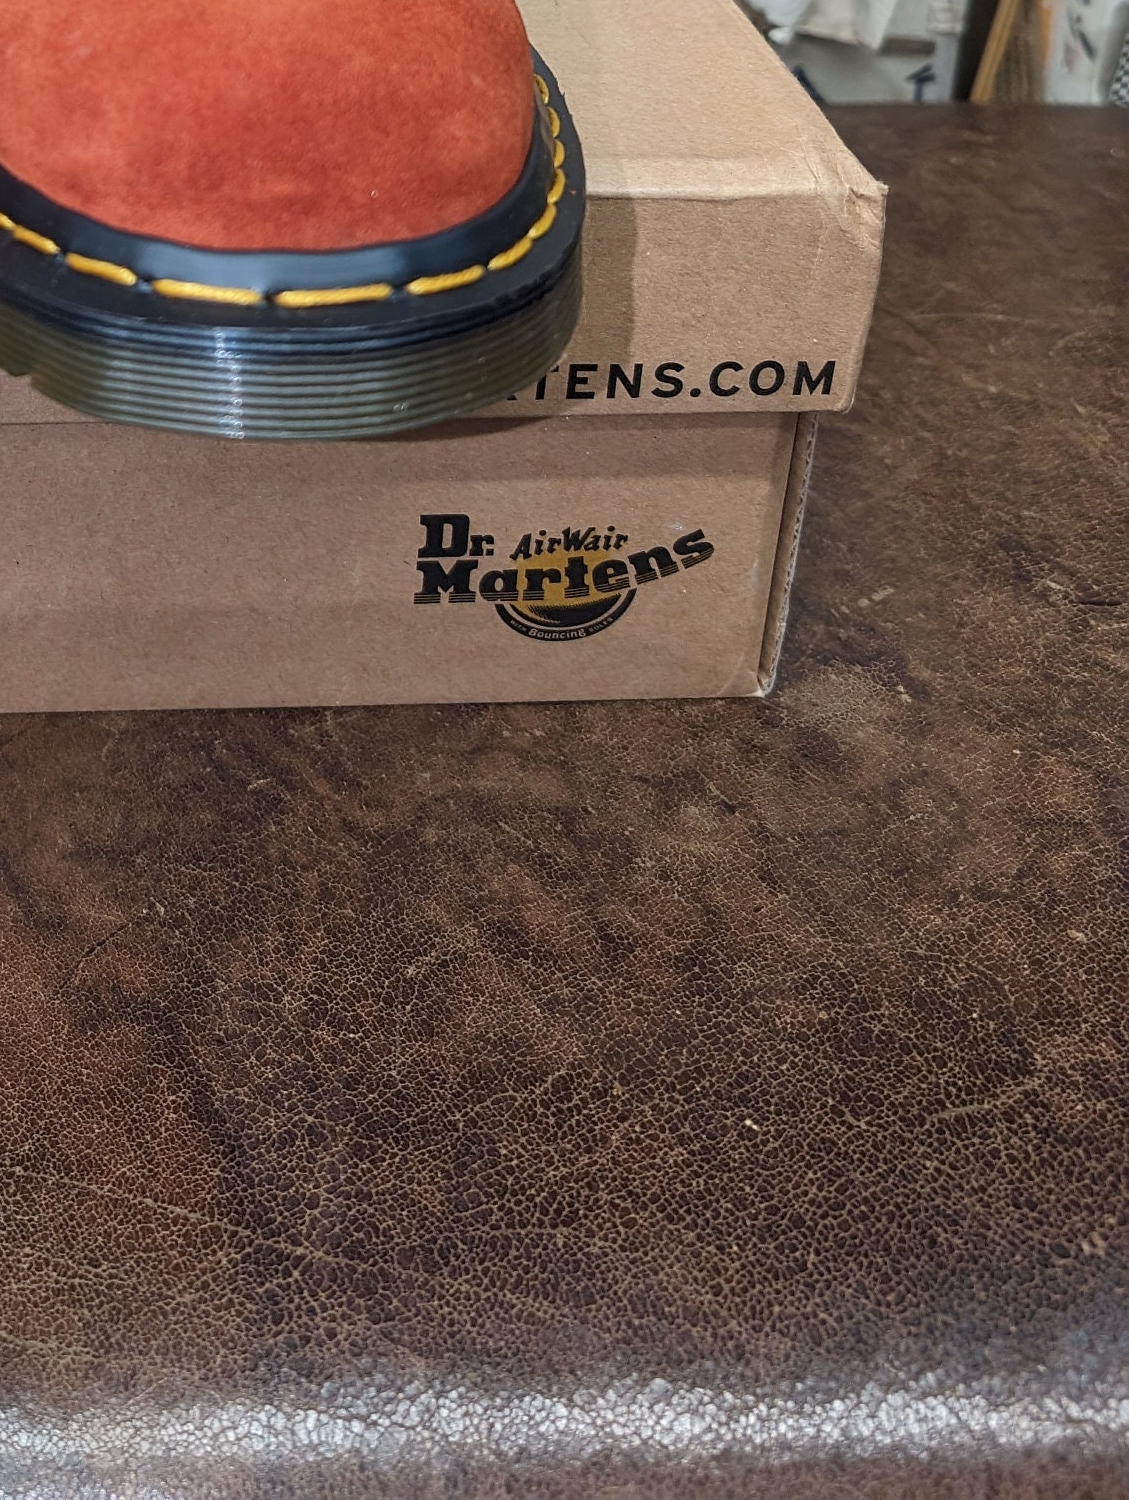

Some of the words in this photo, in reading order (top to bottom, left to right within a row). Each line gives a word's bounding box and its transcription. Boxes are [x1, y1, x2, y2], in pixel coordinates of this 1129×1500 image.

[508, 359, 836, 402] TENS.COM
[417, 513, 495, 559] Dr.
[509, 525, 629, 561] AirWair
[413, 528, 715, 605] Martens
[528, 628, 586, 639] Bouncing
